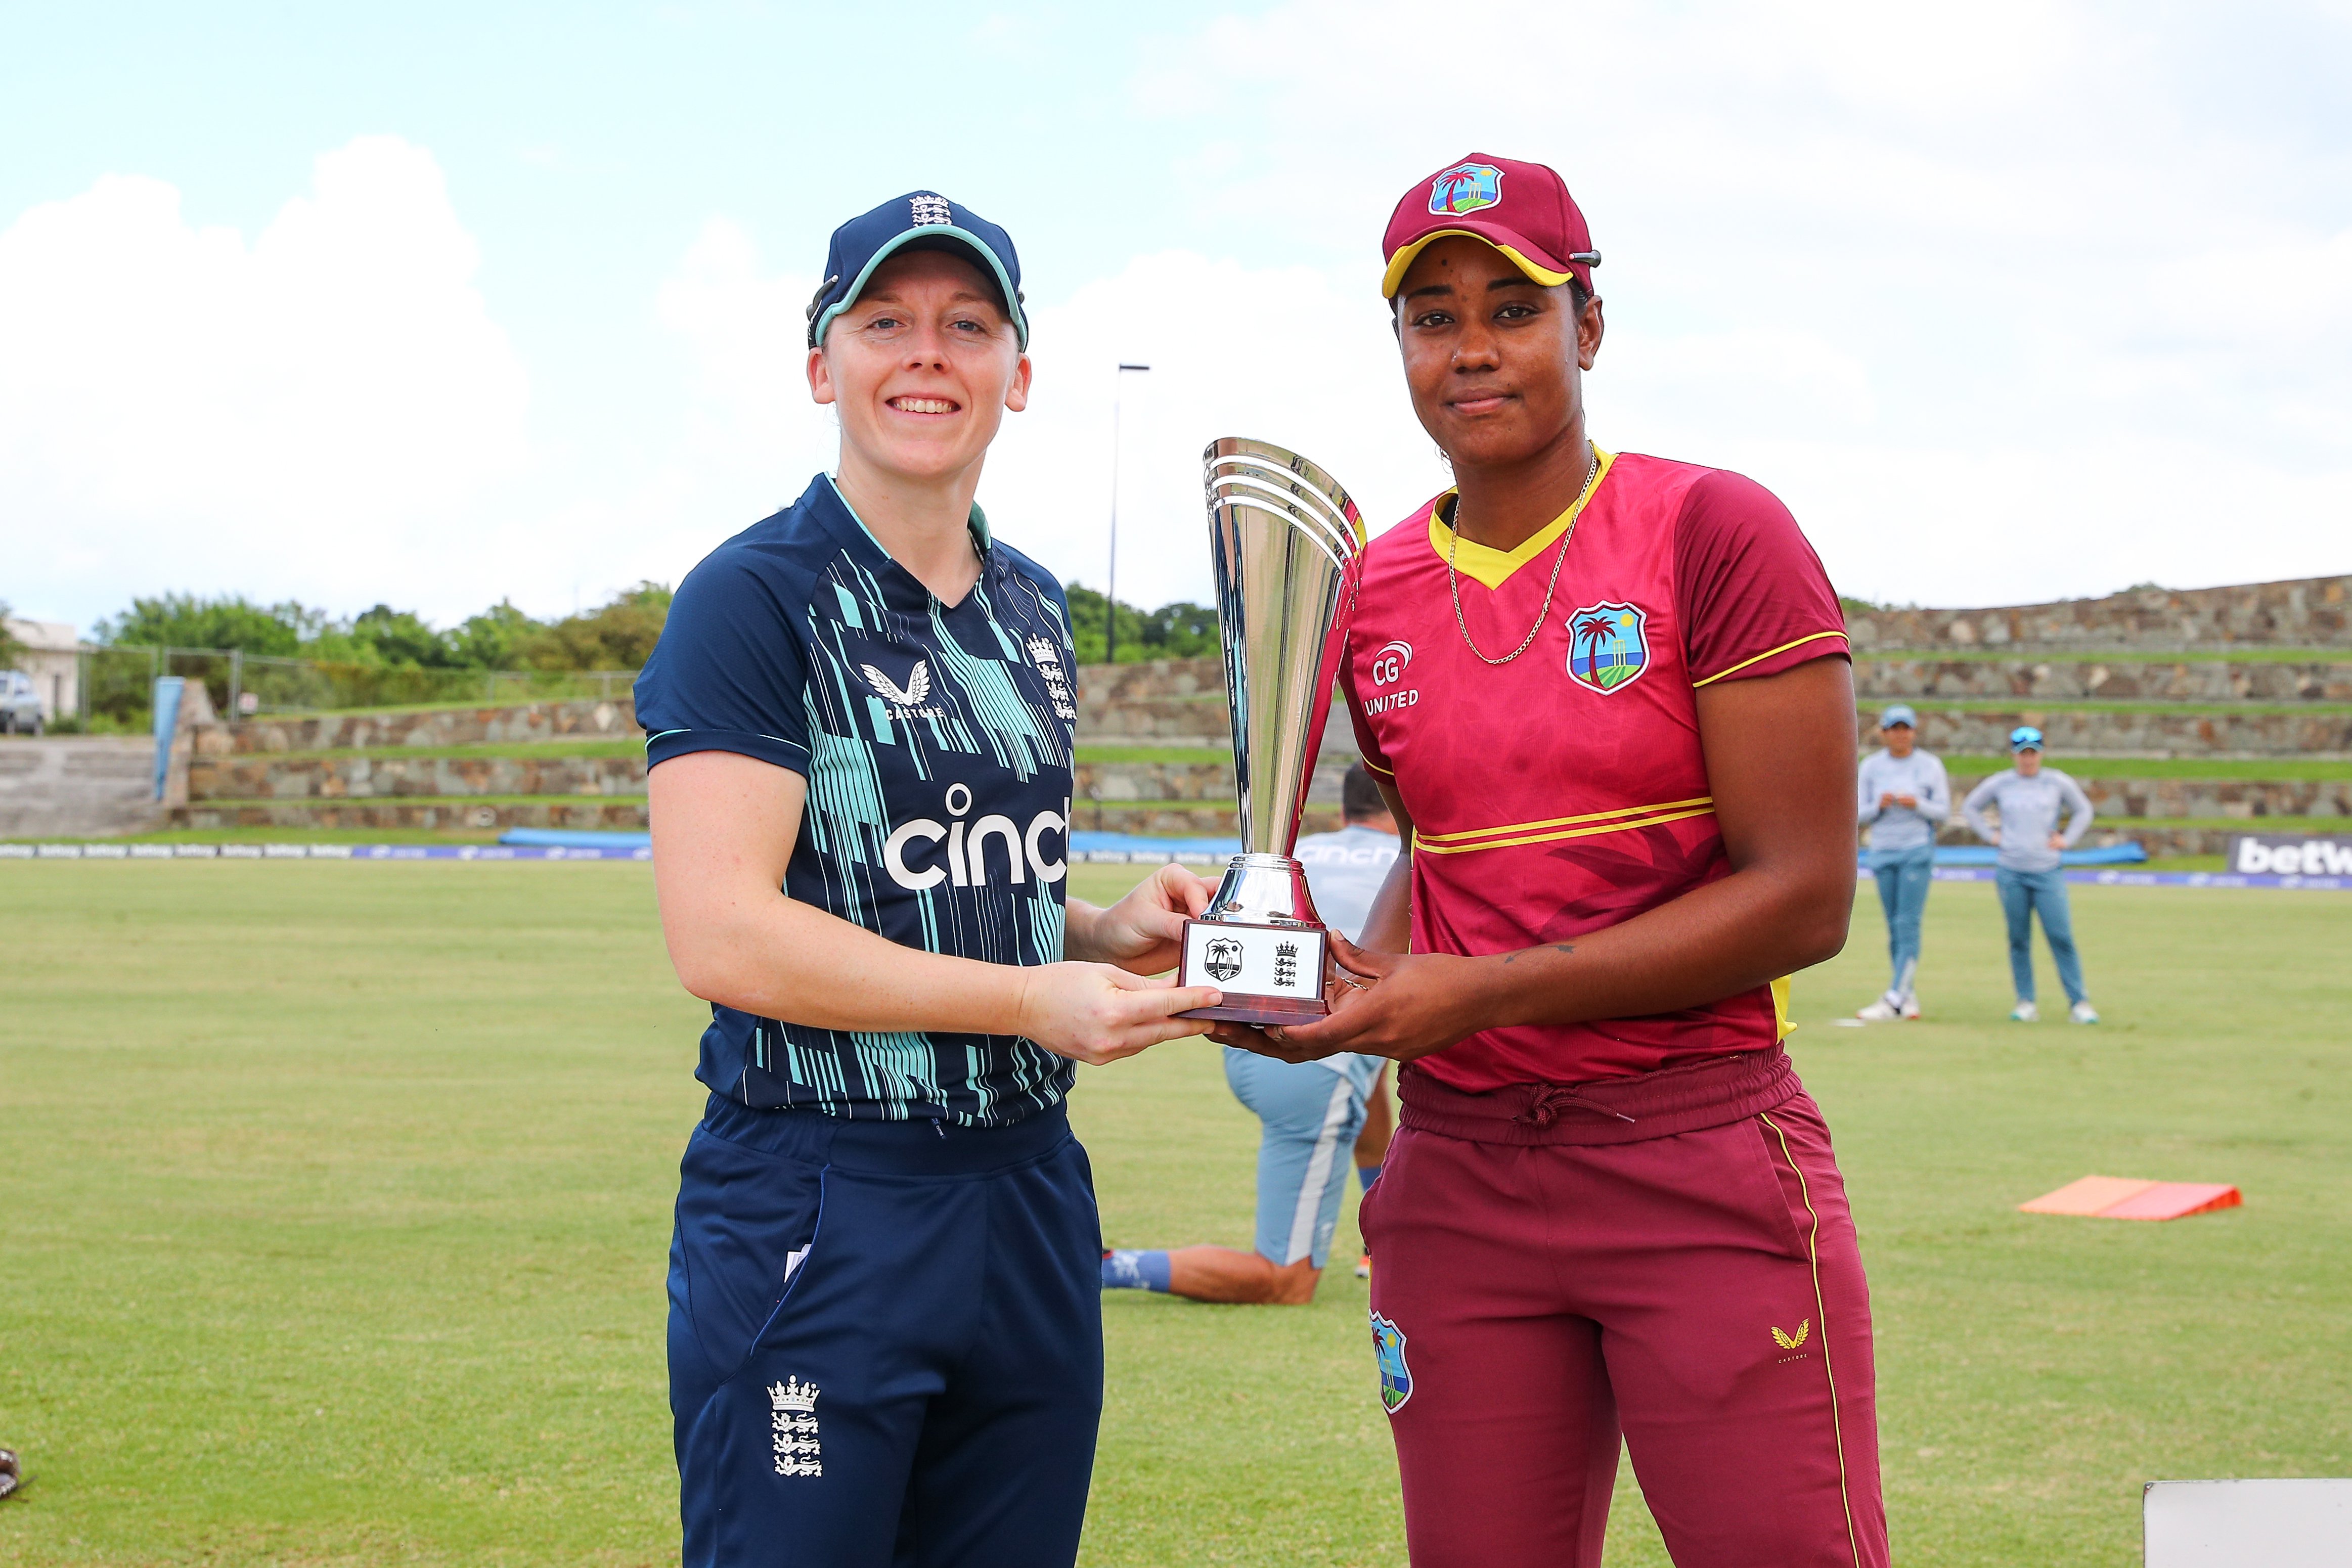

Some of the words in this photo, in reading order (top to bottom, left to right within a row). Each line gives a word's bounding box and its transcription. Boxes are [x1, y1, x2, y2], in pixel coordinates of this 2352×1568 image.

[1373, 657, 1399, 686] CG
[1365, 689, 1418, 716] UNITED
[885, 707, 945, 720] CASTORE
[1778, 1353, 1807, 1363] CASTORE
